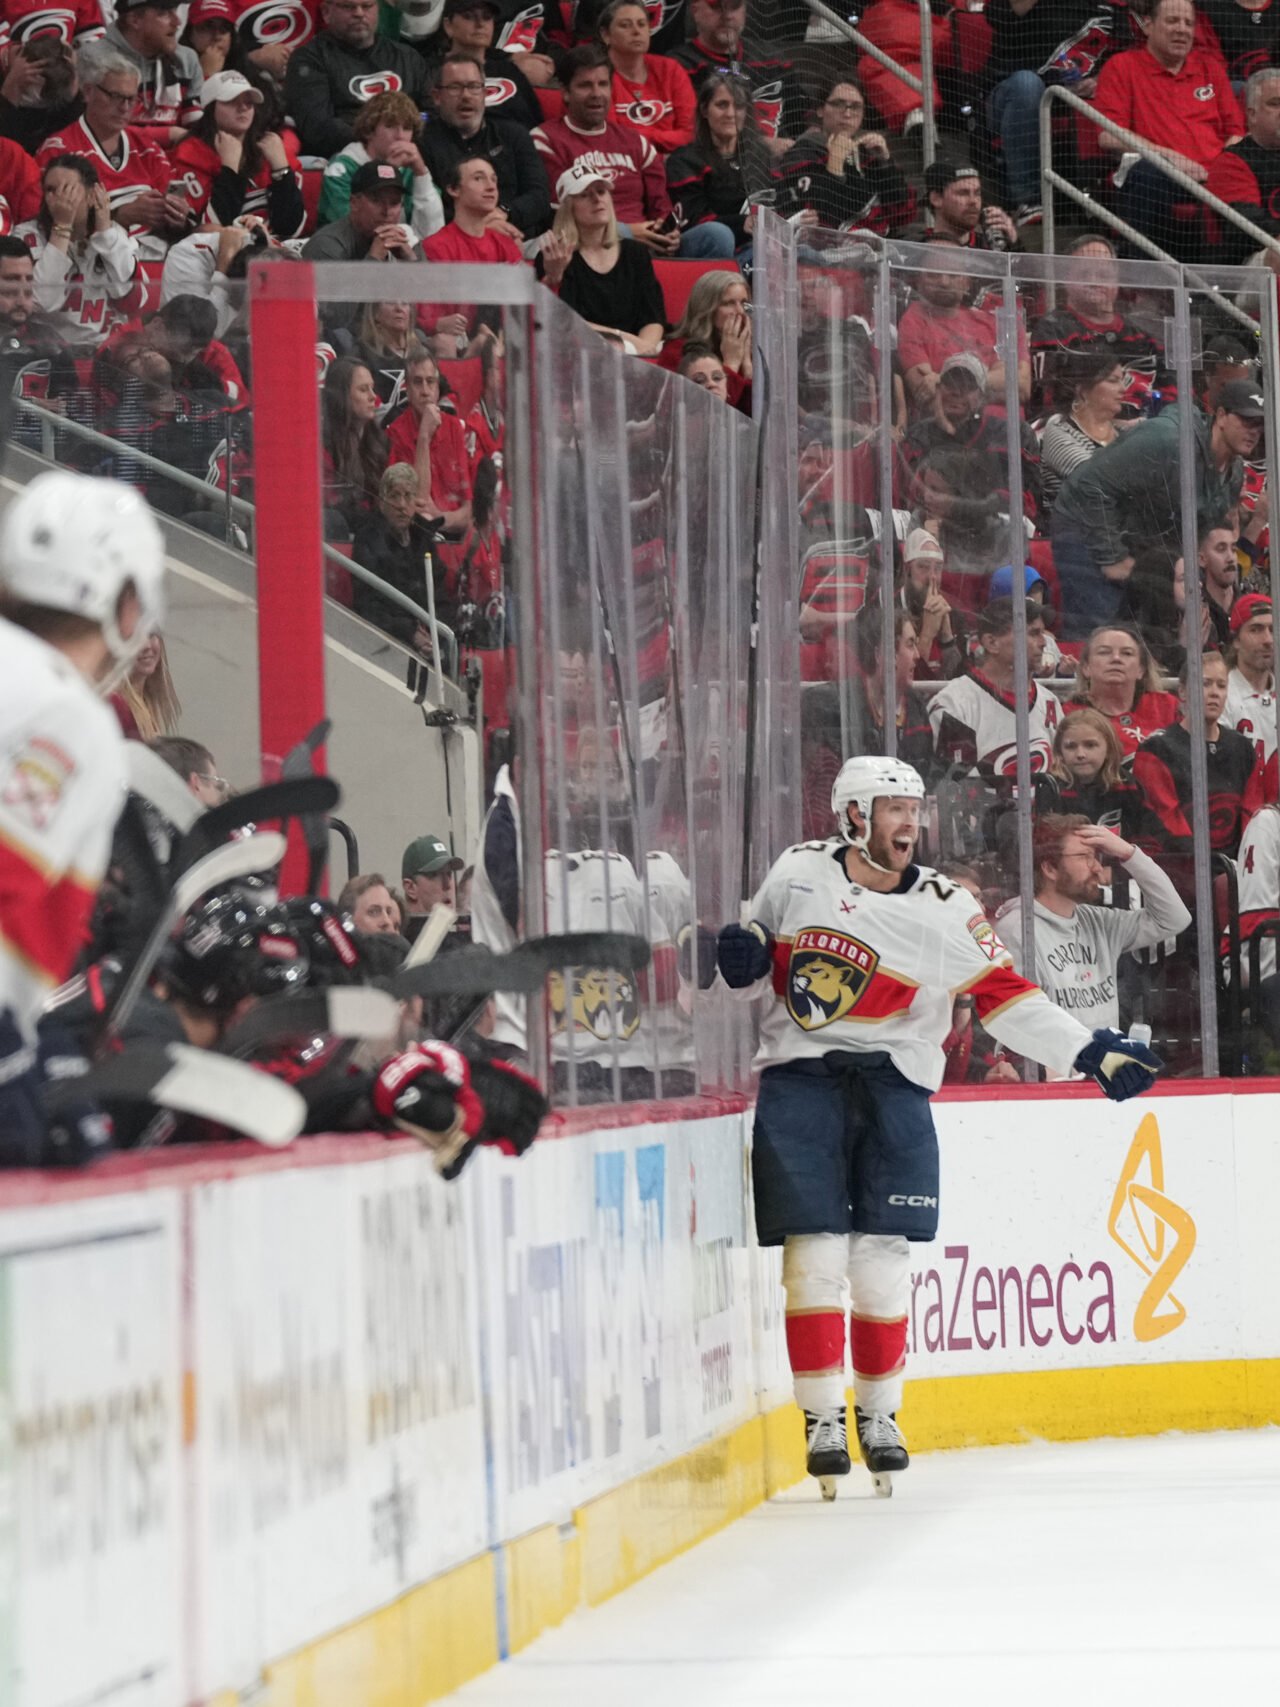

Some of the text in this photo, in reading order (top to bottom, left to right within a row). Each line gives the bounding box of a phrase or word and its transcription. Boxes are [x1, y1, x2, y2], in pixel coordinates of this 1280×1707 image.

[1044, 700, 1058, 729] A
[798, 933, 870, 968] FLORIDA
[887, 1193, 938, 1209] CCM
[907, 1245, 1118, 1354] raZeneca
